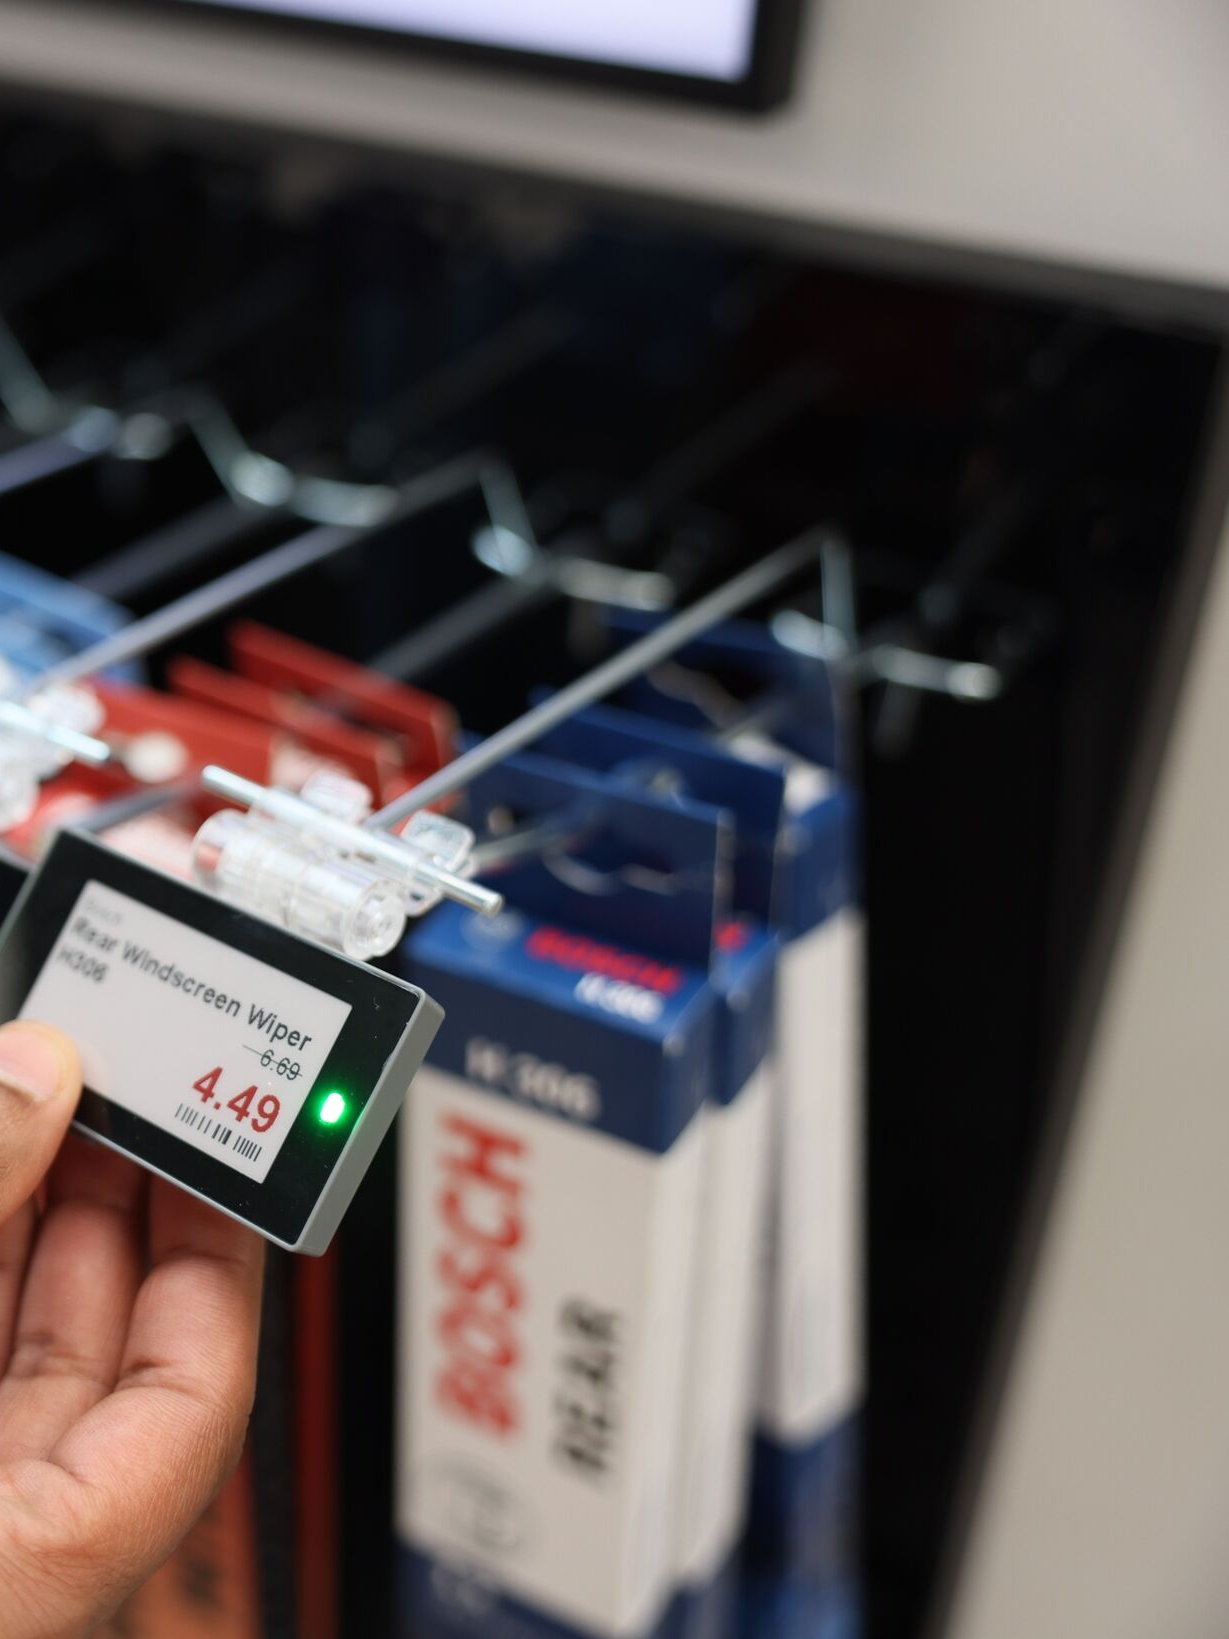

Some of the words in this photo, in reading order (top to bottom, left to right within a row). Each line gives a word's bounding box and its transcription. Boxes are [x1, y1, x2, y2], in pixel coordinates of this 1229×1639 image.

[57, 947, 109, 985] H306
[71, 916, 120, 956] Rear
[121, 941, 242, 1017] Windscreen
[247, 1003, 312, 1052] Wiper
[527, 927, 680, 992] BOSCH
[259, 1048, 302, 1082] 6.69
[192, 1066, 281, 1134] 4.49
[432, 1107, 531, 1438] BOSCH
[552, 1293, 624, 1477] REAR
